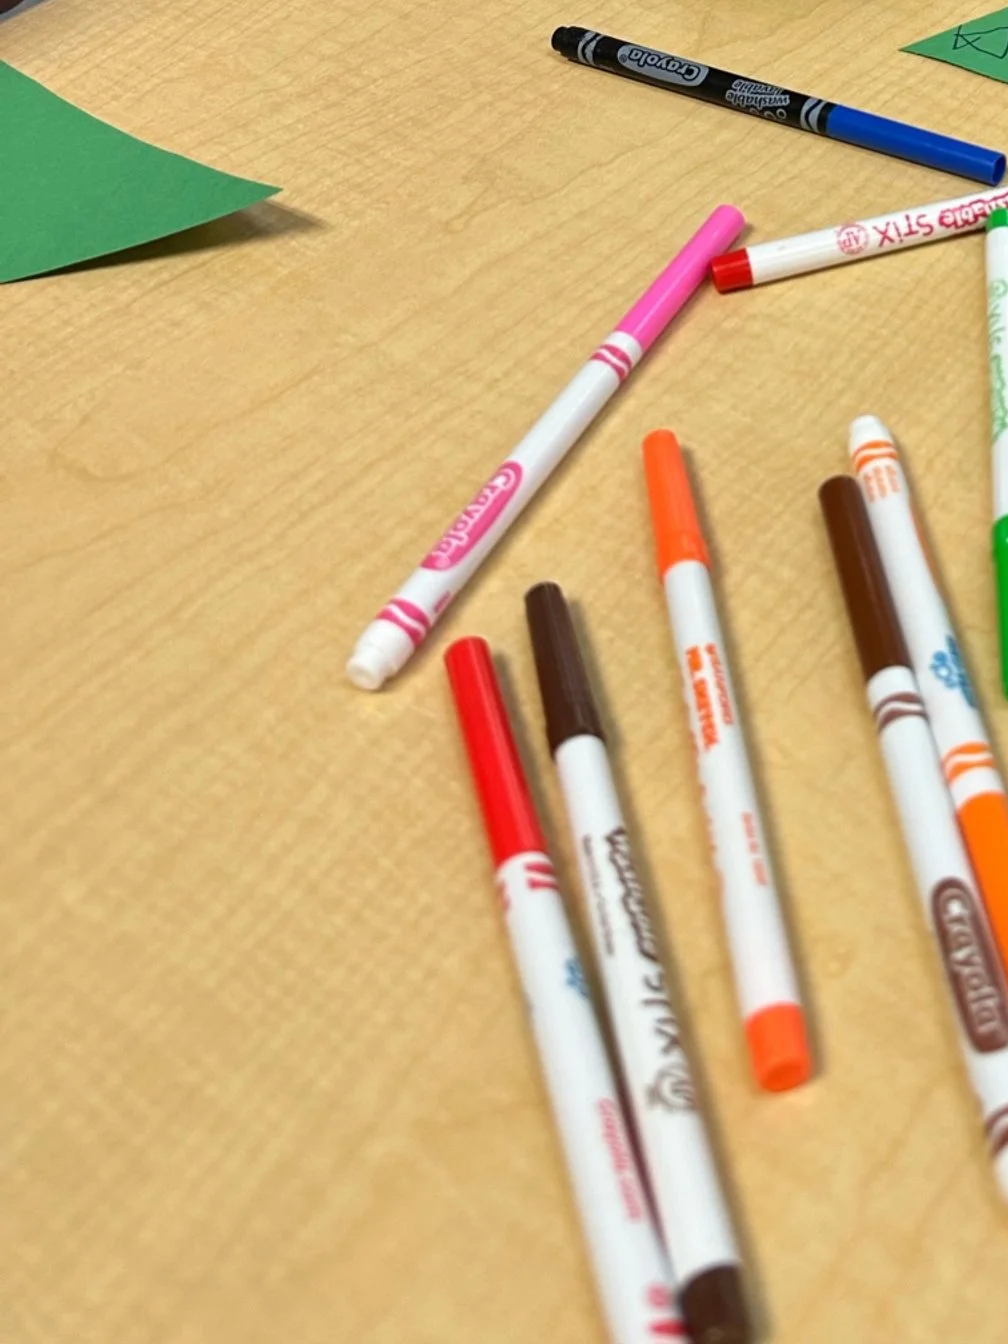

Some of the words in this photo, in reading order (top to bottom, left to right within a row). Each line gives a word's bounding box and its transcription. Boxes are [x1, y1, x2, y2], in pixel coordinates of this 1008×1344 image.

[627, 47, 701, 82] Crayola
[724, 88, 791, 111] washable
[434, 466, 517, 560] Crayola
[939, 889, 1001, 1034] Crayola
